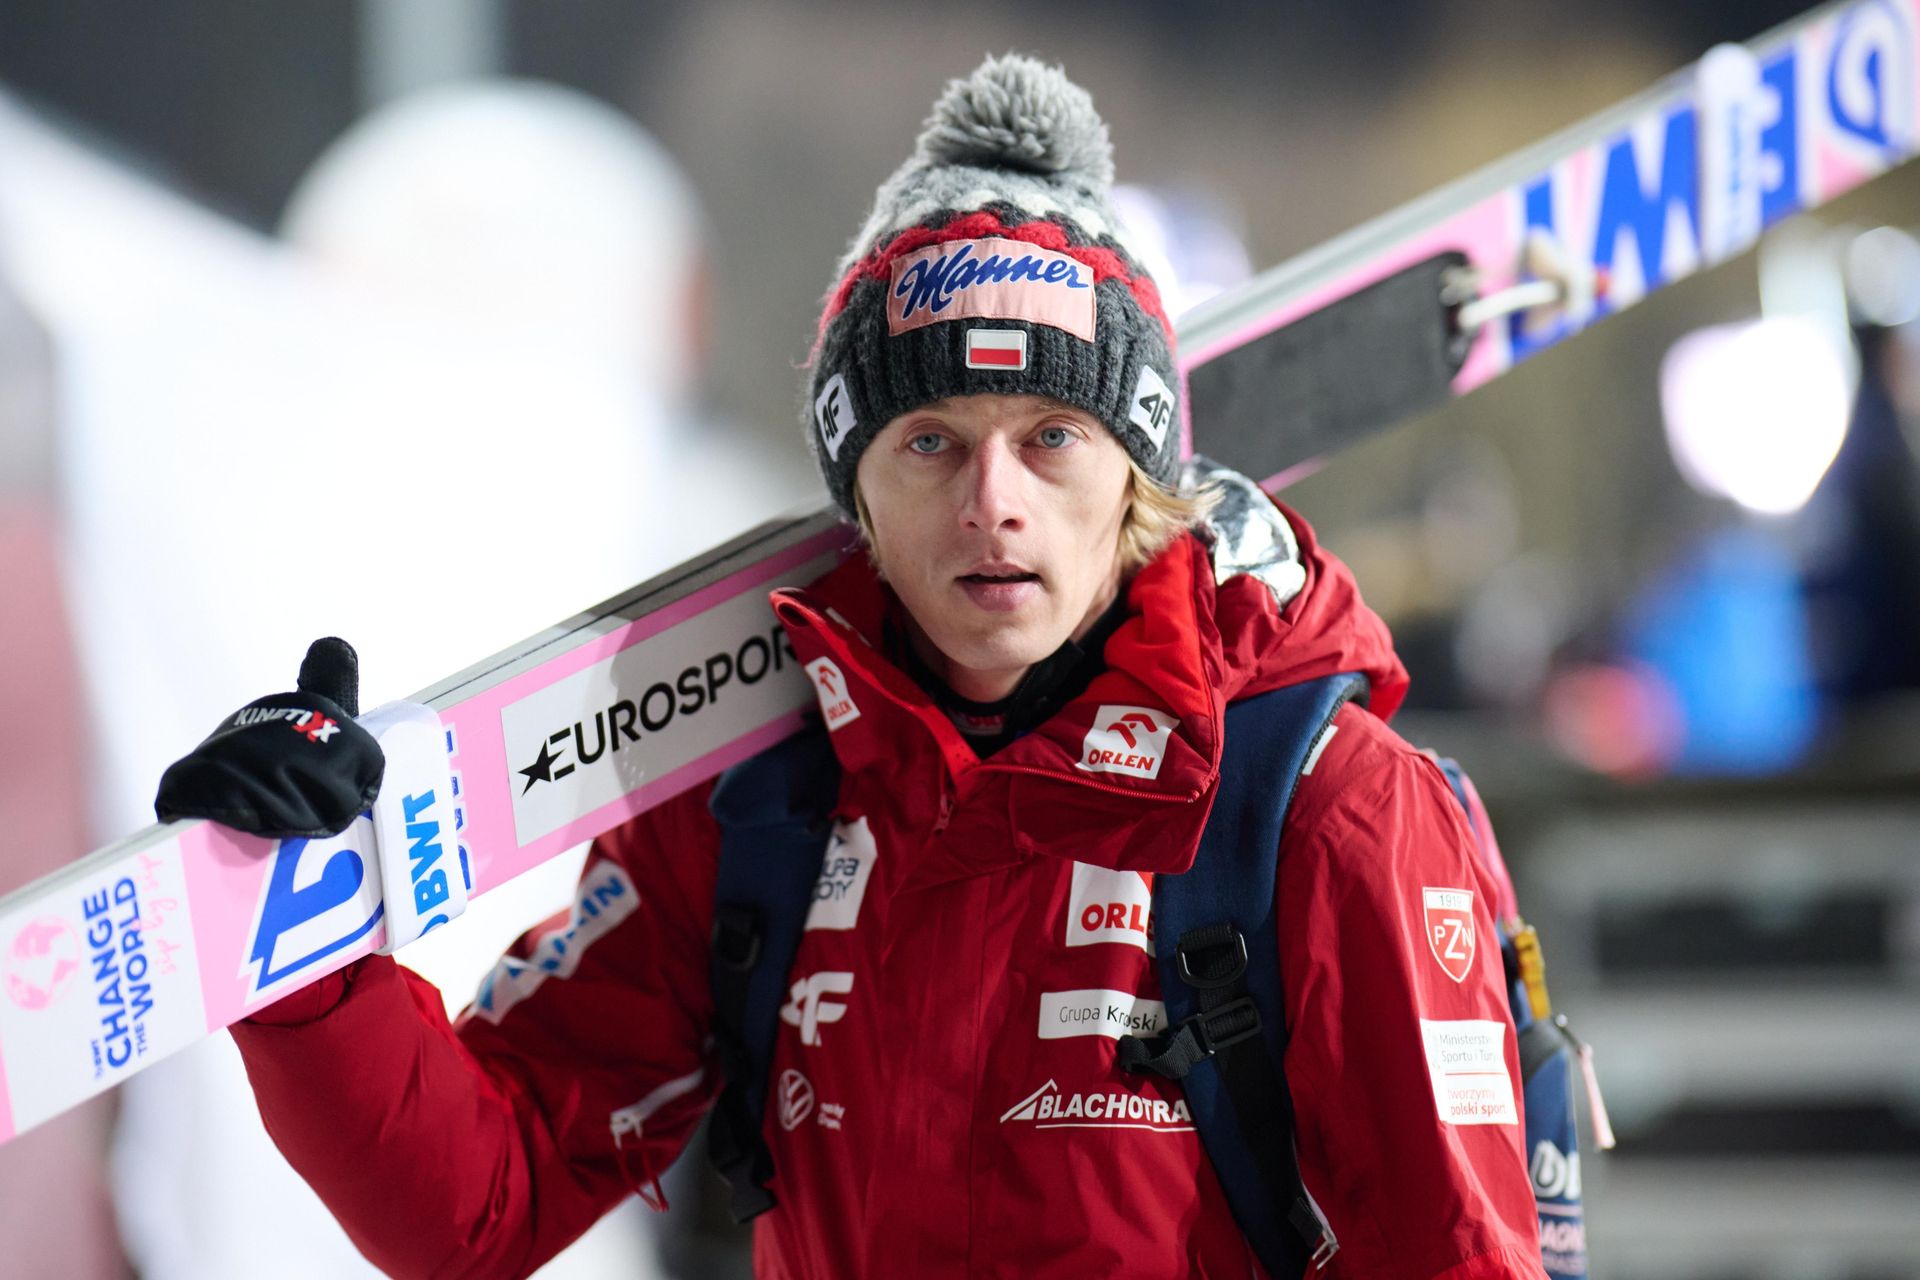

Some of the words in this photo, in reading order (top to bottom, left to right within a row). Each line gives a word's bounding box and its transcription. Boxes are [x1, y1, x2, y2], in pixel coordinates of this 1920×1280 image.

[896, 243, 1089, 319] Manner
[1139, 392, 1170, 430] 4F
[1088, 748, 1155, 771] ORLEN
[402, 789, 449, 916] BWT
[1081, 902, 1154, 940] ORL
[113, 877, 154, 1020] WORLD
[83, 889, 132, 1068] CHANGE
[1059, 1006, 1100, 1024] Grupa
[135, 1022, 148, 1056] THE
[1442, 1050, 1472, 1063] Sportu
[1450, 1101, 1478, 1115] polski
